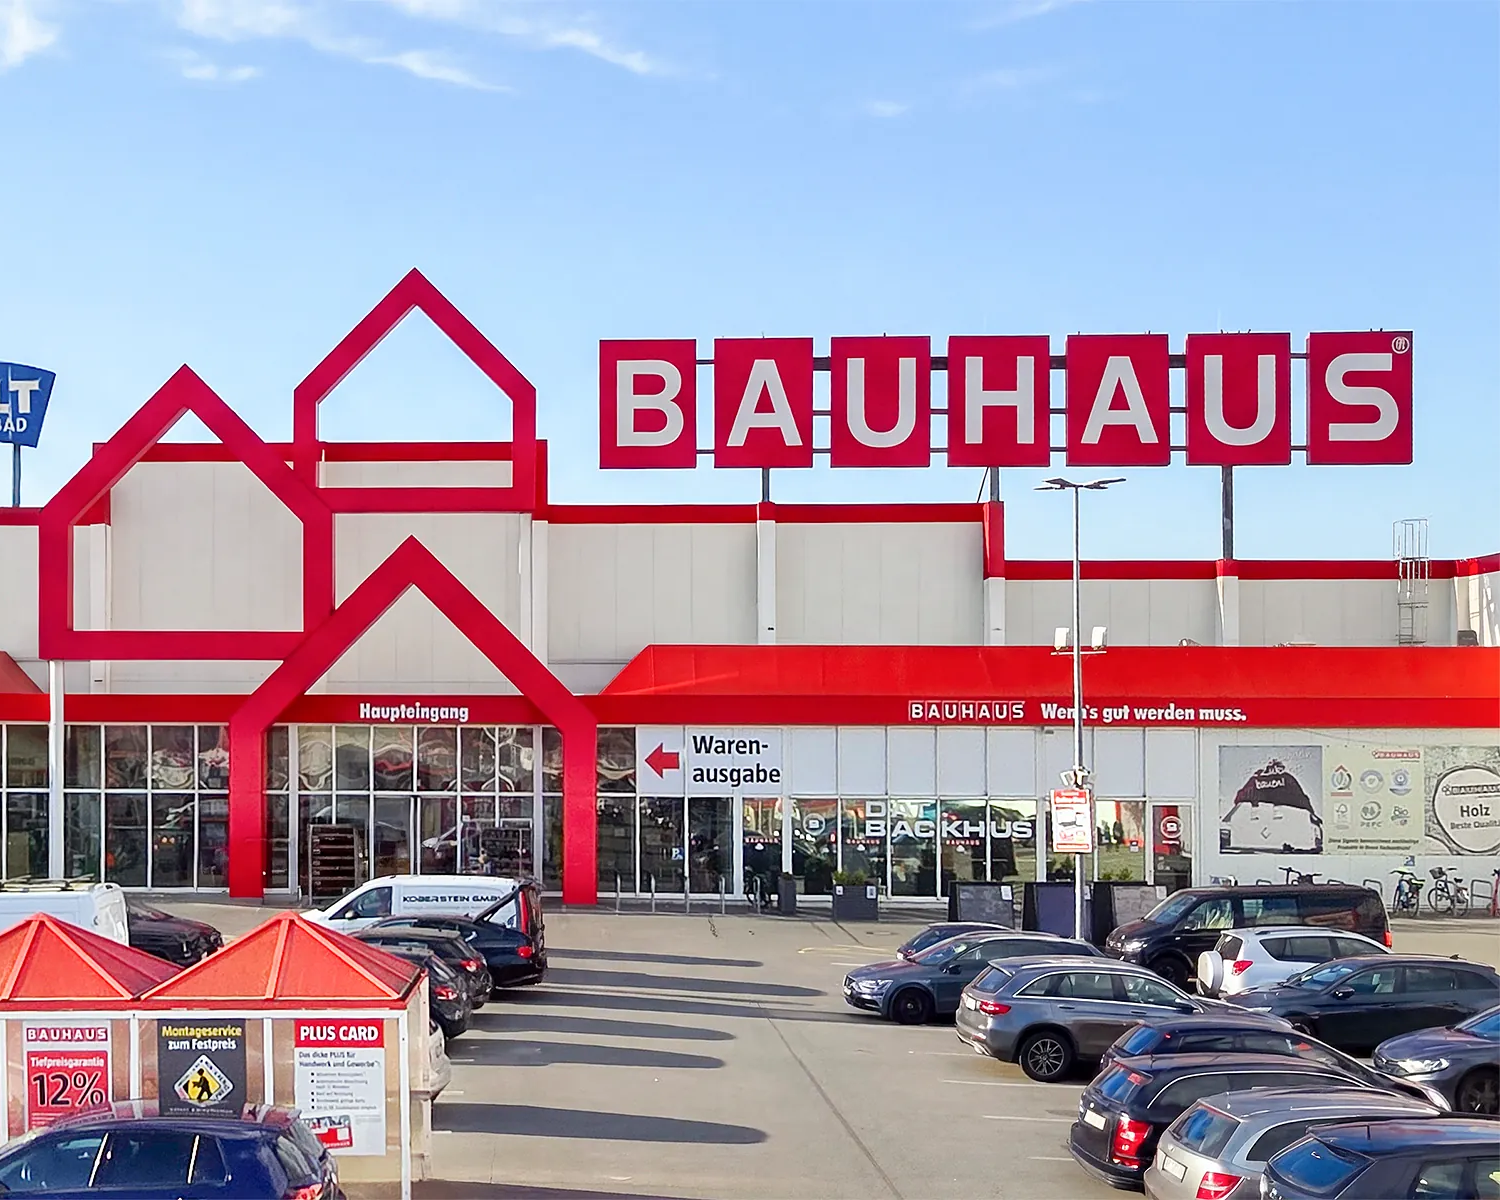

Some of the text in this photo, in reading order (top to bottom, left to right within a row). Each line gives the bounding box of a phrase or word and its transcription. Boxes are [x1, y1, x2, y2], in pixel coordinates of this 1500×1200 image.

[615, 353, 1400, 448] BAUHAUS
[359, 701, 469, 723] Haupteingang
[911, 702, 1024, 719] BAUHAUS
[1102, 704, 1130, 723] gut
[1134, 703, 1195, 719] werden
[1199, 707, 1247, 720] muss.
[692, 735, 769, 755] Waren-
[692, 762, 781, 788] ausgabe
[1460, 803, 1491, 818] Holz
[865, 820, 1033, 839] BACKHUS
[27, 1028, 108, 1041] BAUHAUS
[162, 1024, 242, 1038] Montageservice
[300, 1025, 379, 1041] PLUS CARD
[168, 1038, 237, 1052] zum Festpreis
[30, 1056, 105, 1069] Tiefpreisgarantie
[32, 1071, 105, 1107] 12%
